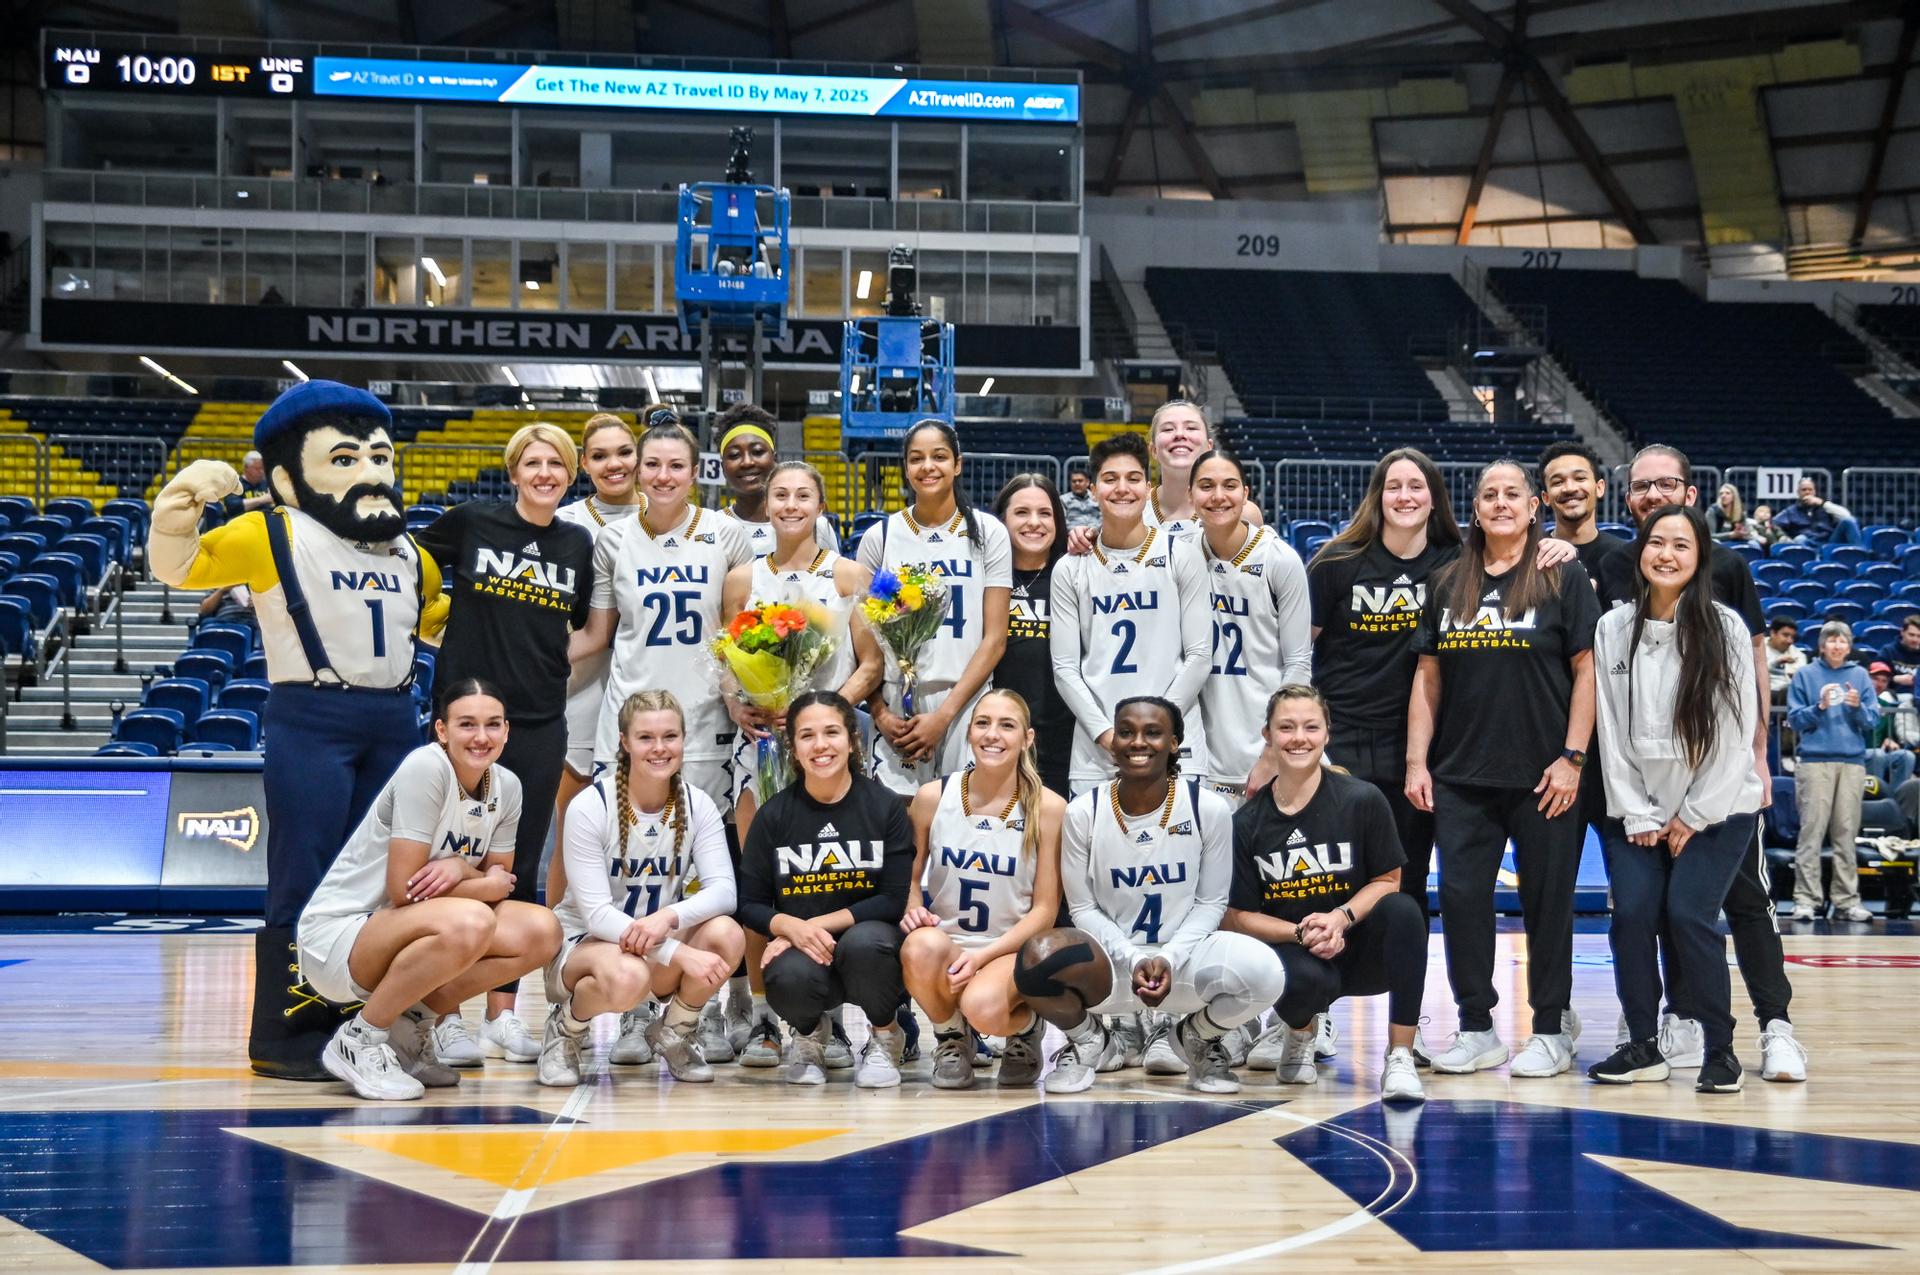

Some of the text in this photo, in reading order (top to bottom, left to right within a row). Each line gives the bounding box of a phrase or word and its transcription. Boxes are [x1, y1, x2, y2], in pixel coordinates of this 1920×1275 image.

[56, 48, 100, 63] NAU
[261, 57, 303, 73] UNC
[67, 64, 90, 83] 0
[118, 56, 196, 84] 10:00
[352, 71, 368, 83] AZ
[371, 72, 400, 85] Travel
[271, 74, 294, 93] 0
[535, 77, 869, 103] Get The New AZ Travel ID By May 7, 2025
[908, 90, 1015, 108] AZTravelID.com
[1237, 235, 1280, 257] 209
[1522, 251, 1563, 269] 207
[308, 315, 833, 355] NORTHERN ARINA
[699, 459, 721, 479] 13
[1766, 474, 1794, 494] 111
[476, 548, 575, 594] NAU
[637, 565, 708, 587] NAU
[930, 559, 972, 578] AU
[329, 571, 402, 593] NAU
[488, 575, 560, 598] WOMEN'S
[474, 582, 572, 611] BASKETBALL
[1092, 590, 1158, 615] NAU
[1210, 592, 1249, 616] AU
[643, 590, 703, 647] 25
[941, 585, 967, 639] 4
[1439, 606, 1536, 632] NAU
[364, 599, 386, 658] 1
[1350, 621, 1417, 632] BASKETB
[1446, 630, 1512, 640] WOMEN'S
[1110, 619, 1138, 675] 2
[1215, 786, 1236, 795] NAU
[186, 818, 250, 837] NAU
[610, 856, 683, 878] NAU
[776, 840, 884, 875] NAU
[941, 846, 1017, 877] NAU
[1254, 842, 1351, 881] NAU
[793, 871, 866, 883] WOMEN'S
[1110, 862, 1186, 889] NAU
[1269, 874, 1335, 891] WOMEN'S
[782, 881, 875, 896] BASKETBAL
[622, 884, 663, 918] 11
[958, 876, 990, 932] 5
[1131, 892, 1164, 944] 4
